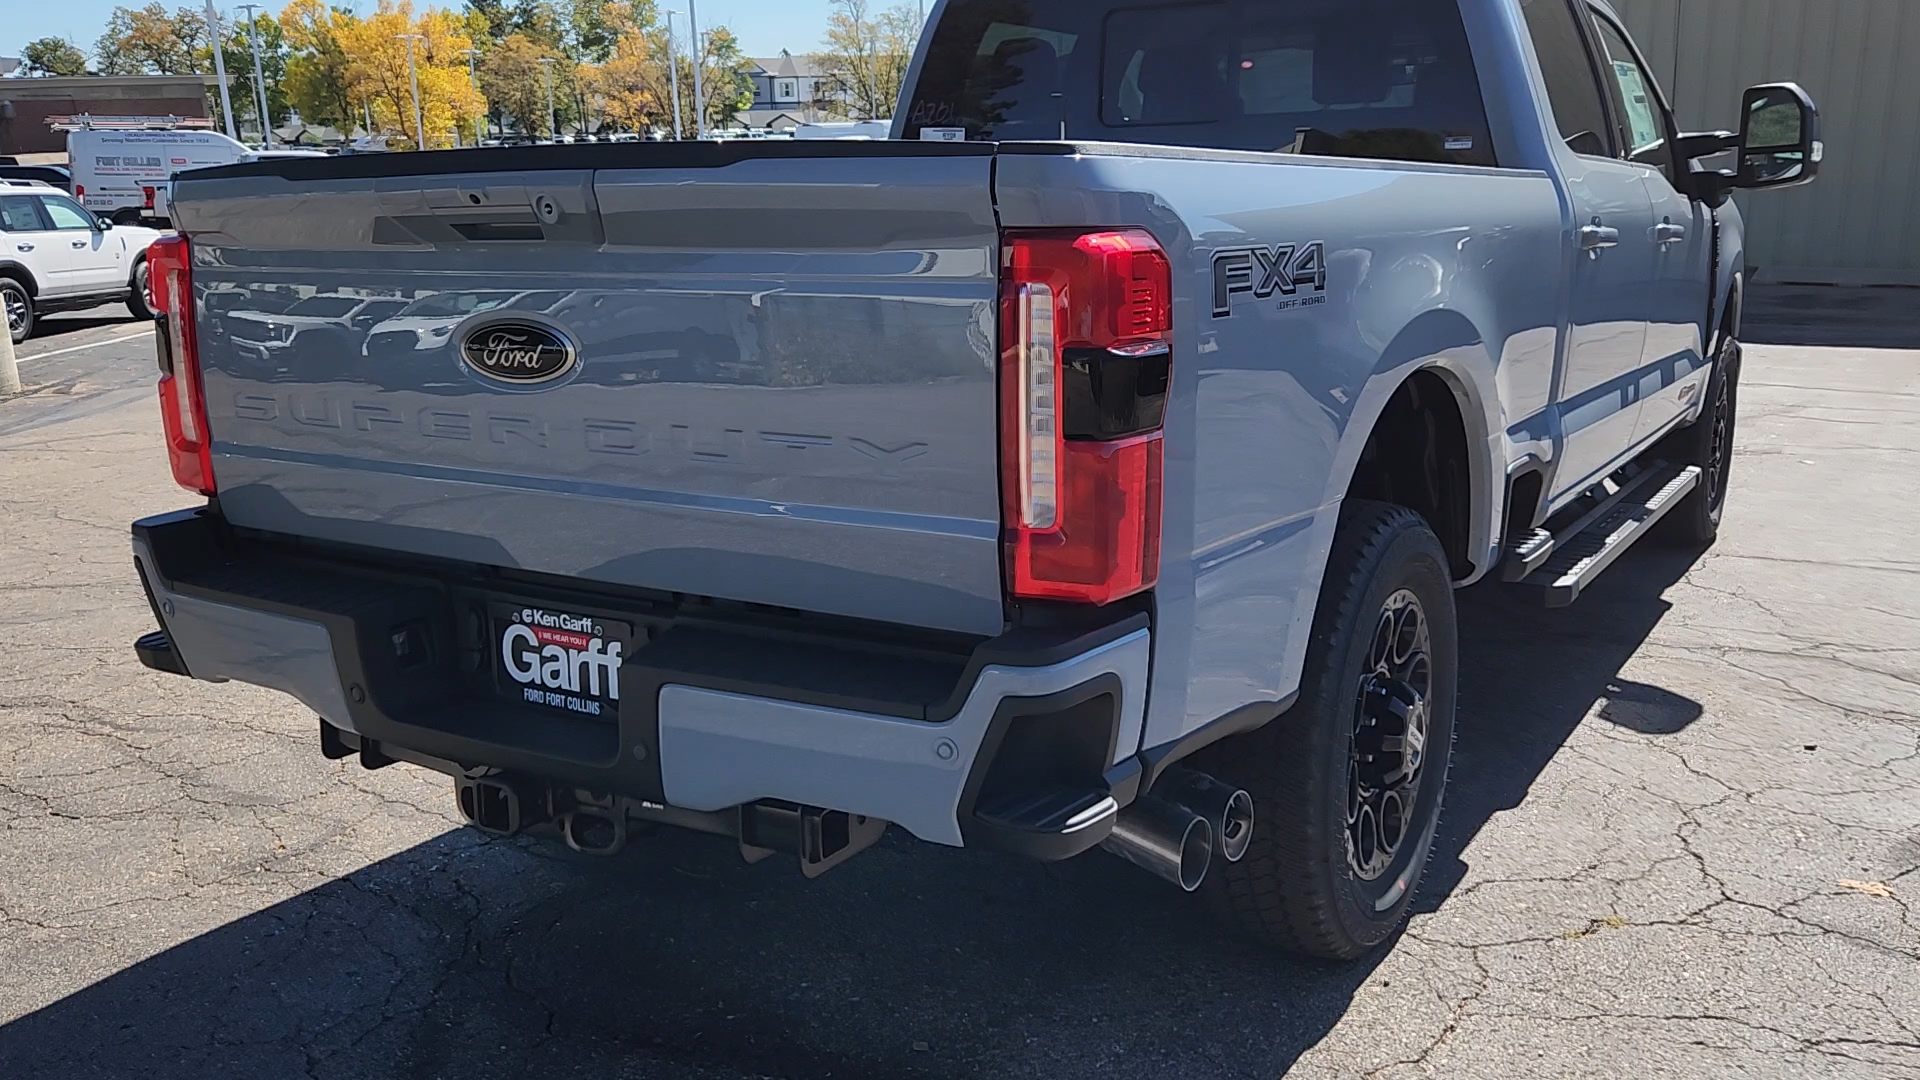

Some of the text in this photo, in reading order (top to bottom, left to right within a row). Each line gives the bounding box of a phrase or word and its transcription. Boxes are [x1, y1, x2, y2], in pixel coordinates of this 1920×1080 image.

[95, 156, 121, 166] FORT
[1210, 240, 1327, 320] FX4
[1278, 295, 1326, 310] OFF ROAD
[483, 332, 543, 369] Ford
[233, 391, 928, 478] SUPER DUTY
[533, 609, 592, 633] Ken Garff
[542, 632, 582, 646] WE HEAR YOU
[502, 623, 622, 700] Garff
[523, 688, 600, 715] FORD FORT COLLINS
